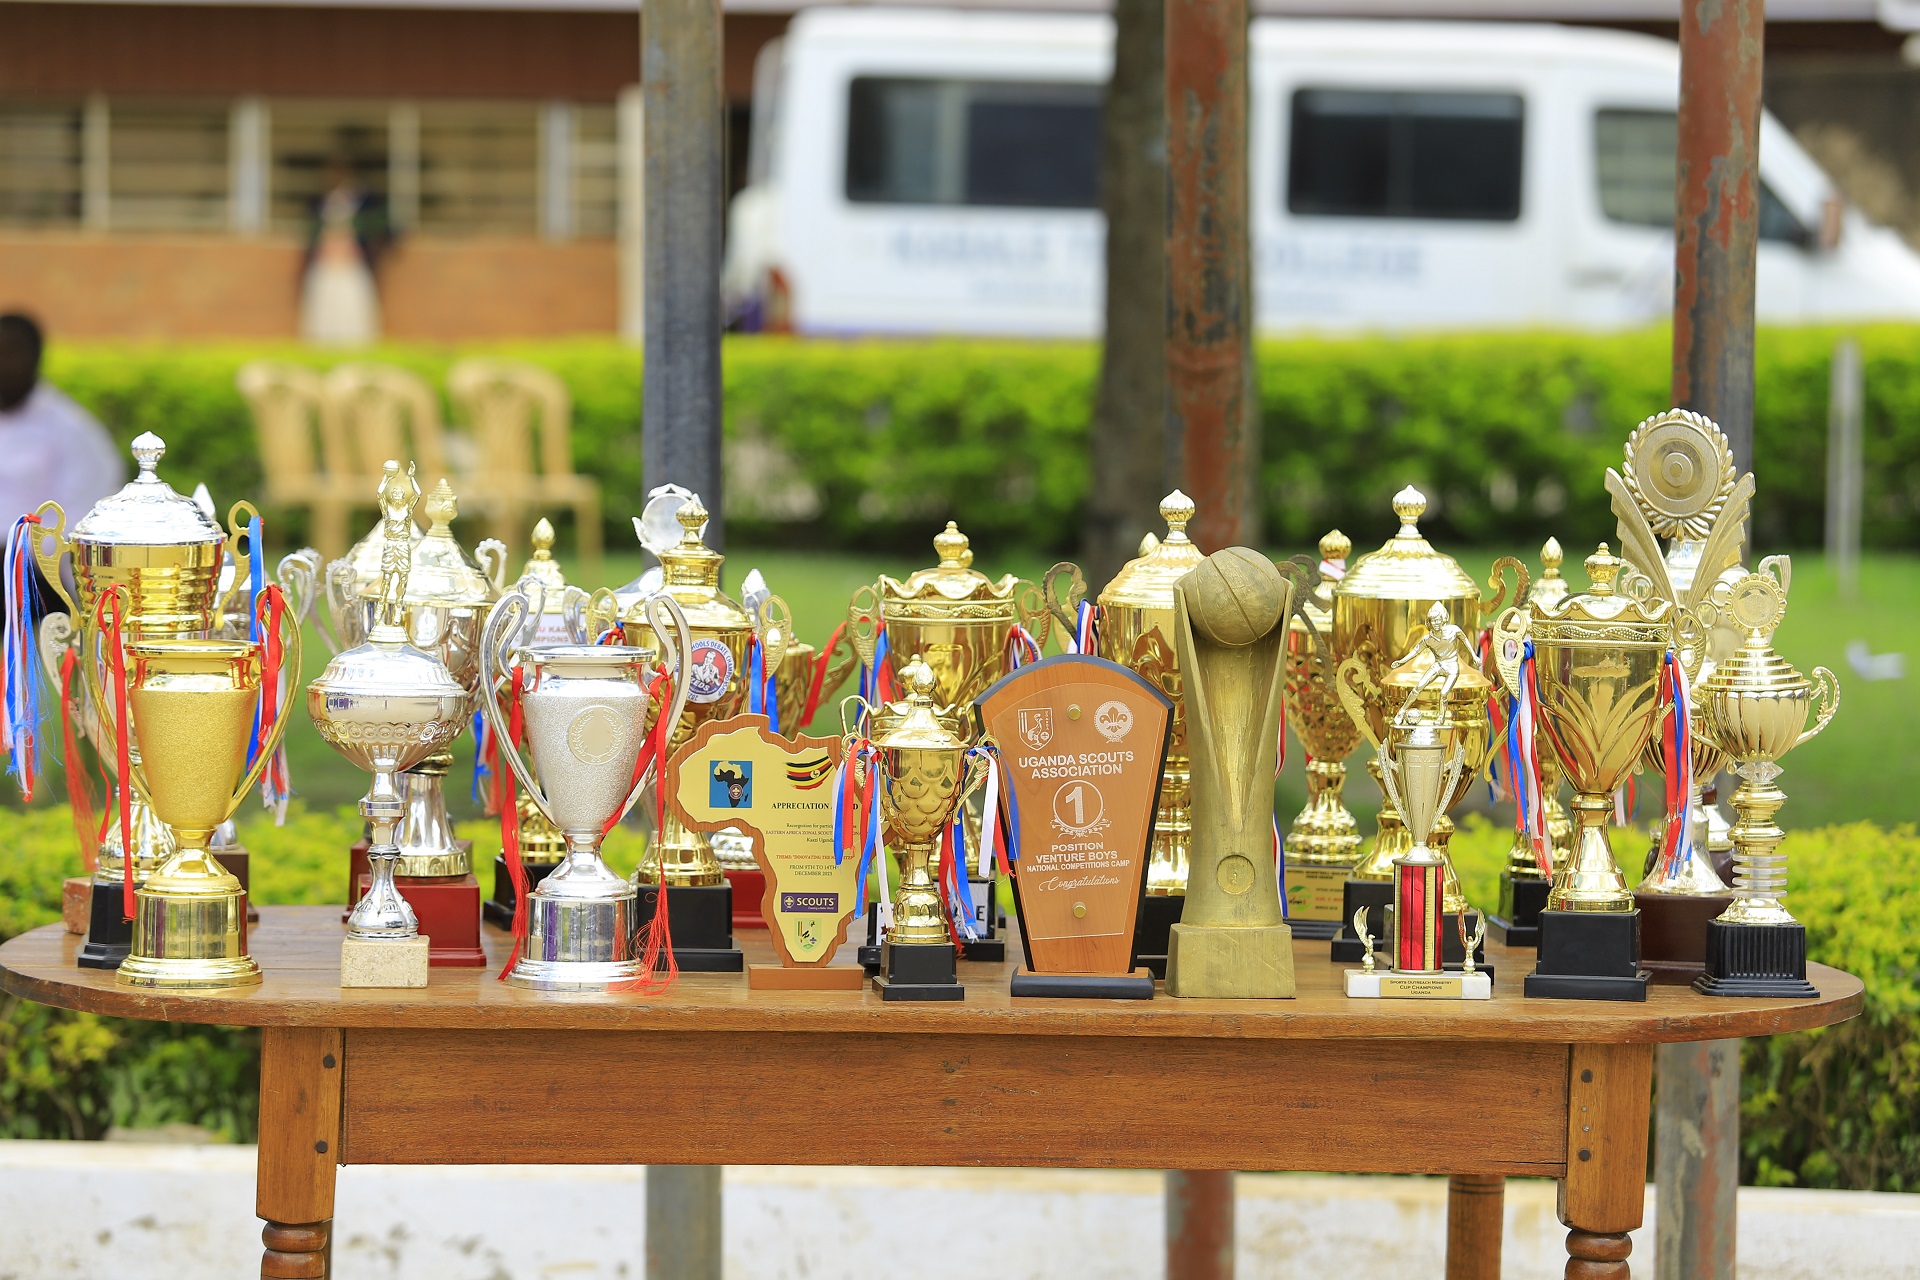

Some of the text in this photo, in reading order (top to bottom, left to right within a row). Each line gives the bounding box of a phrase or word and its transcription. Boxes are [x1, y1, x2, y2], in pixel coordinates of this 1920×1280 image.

[710, 641, 728, 655] DEBATE
[1018, 751, 1134, 768] UGANDA SCOUTS
[1031, 763, 1123, 779] ASSOCIATION
[771, 802, 830, 810] APPRECIATION
[1065, 786, 1084, 824] 1
[1051, 842, 1104, 852] POSITION
[1035, 850, 1118, 864] VENTURE BOYS
[1026, 859, 1130, 873] NATIONAL COMPETITIONS CAMP
[1038, 874, 1120, 891] Congratulations
[796, 897, 835, 906] SCOUTS
